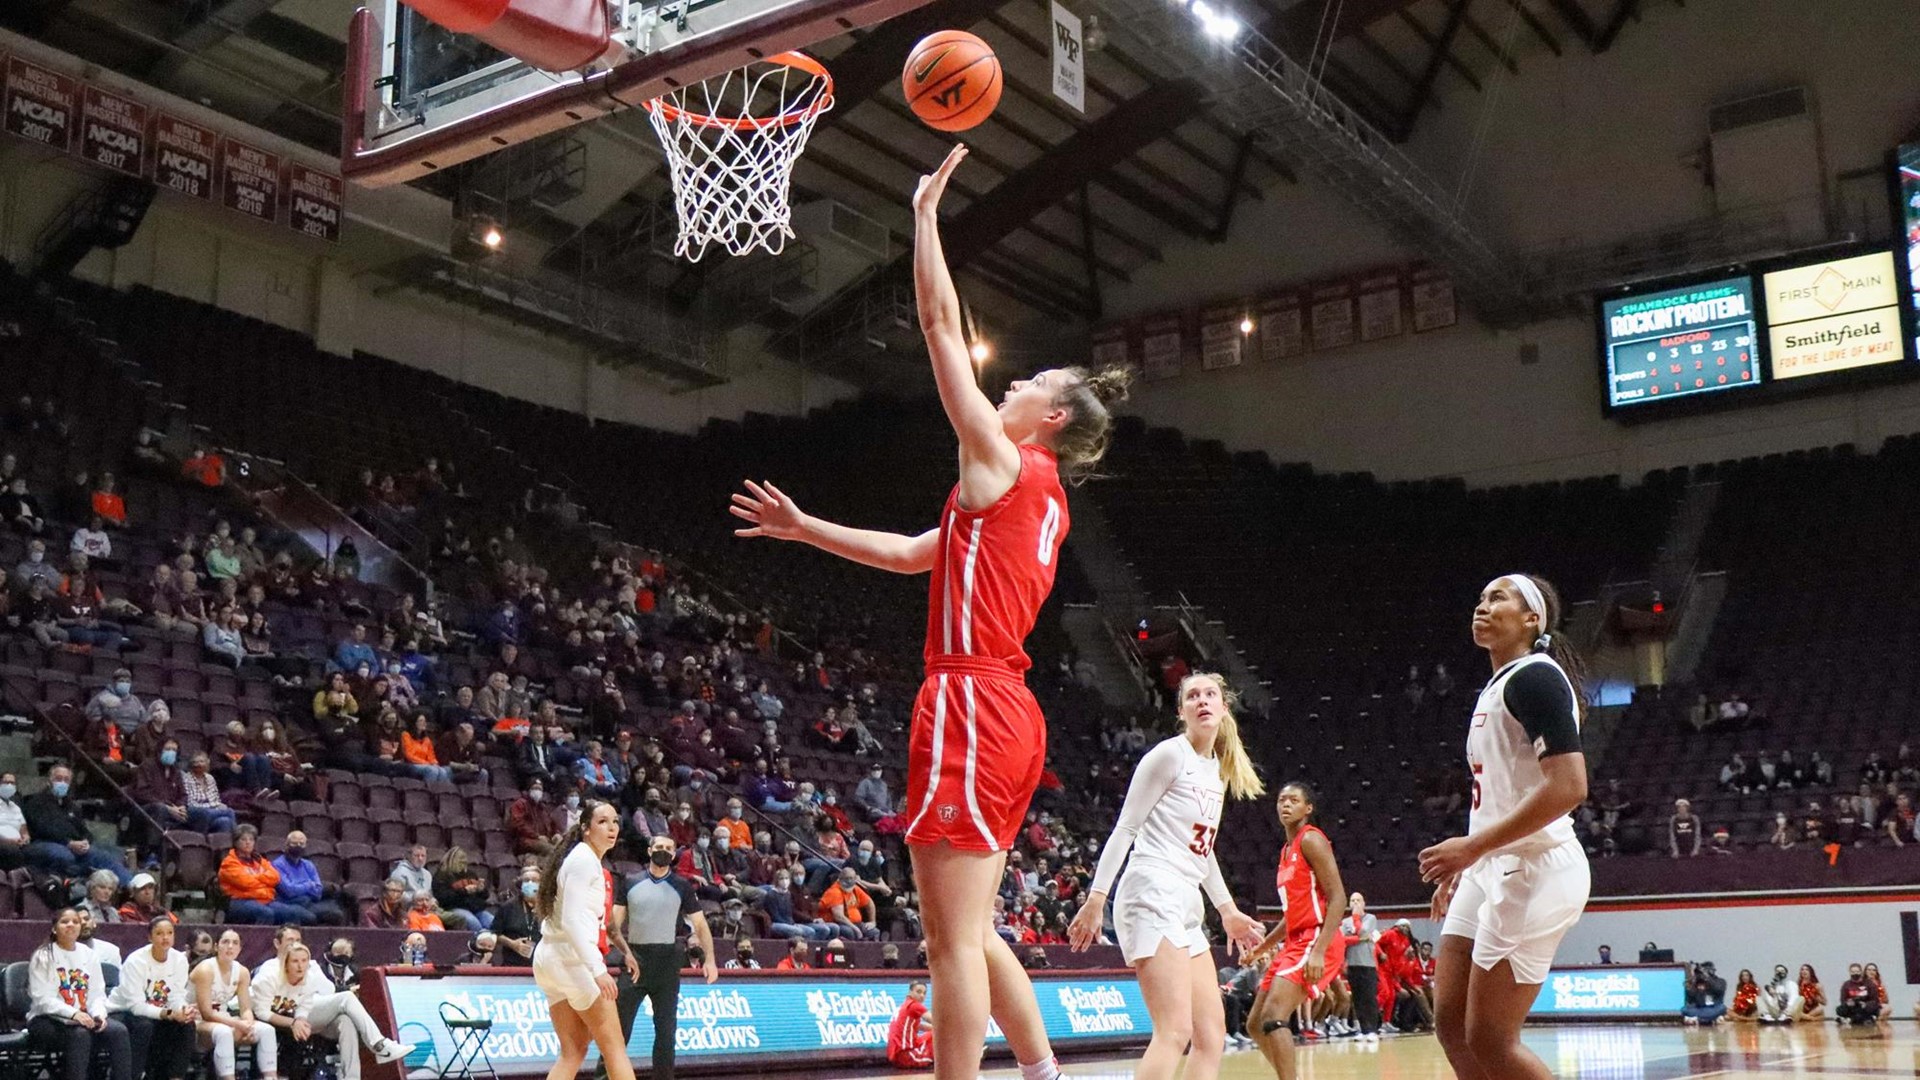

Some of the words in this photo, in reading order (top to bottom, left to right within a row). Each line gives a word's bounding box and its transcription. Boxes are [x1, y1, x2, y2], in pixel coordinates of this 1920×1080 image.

[931, 78, 967, 109] VT
[12, 96, 65, 129] NCAA
[88, 123, 138, 155] NCAA
[97, 146, 126, 168] 2017
[161, 150, 207, 181] NCAA
[168, 171, 199, 196] 2018
[236, 183, 265, 203] NCAA
[236, 197, 263, 216] 2019
[295, 196, 336, 225] NCAA
[303, 218, 328, 238] 2021
[1779, 285, 1820, 302] FIRST
[1841, 275, 1881, 291] MAIN
[1660, 331, 1711, 347] RADFORD
[1785, 321, 1881, 348] Smithfield
[1779, 357, 1797, 369] FOR
[1802, 353, 1818, 363] THE
[1823, 349, 1846, 361] LOVE
[1851, 345, 1863, 357] OF
[1868, 341, 1894, 353] MEAT
[1614, 370, 1647, 383] POINTS
[1616, 388, 1644, 400] FOULS
[1037, 495, 1060, 567] 0
[1574, 974, 1640, 996] English
[476, 991, 554, 1031] Engli
[827, 989, 897, 1023] English
[1073, 985, 1127, 1014] English
[1554, 993, 1640, 1008] Meadows
[815, 1020, 890, 1045] Meadow
[1066, 1012, 1133, 1033] Meadows
[454, 1027, 562, 1058] Meadow
[675, 1025, 760, 1050] eadows
